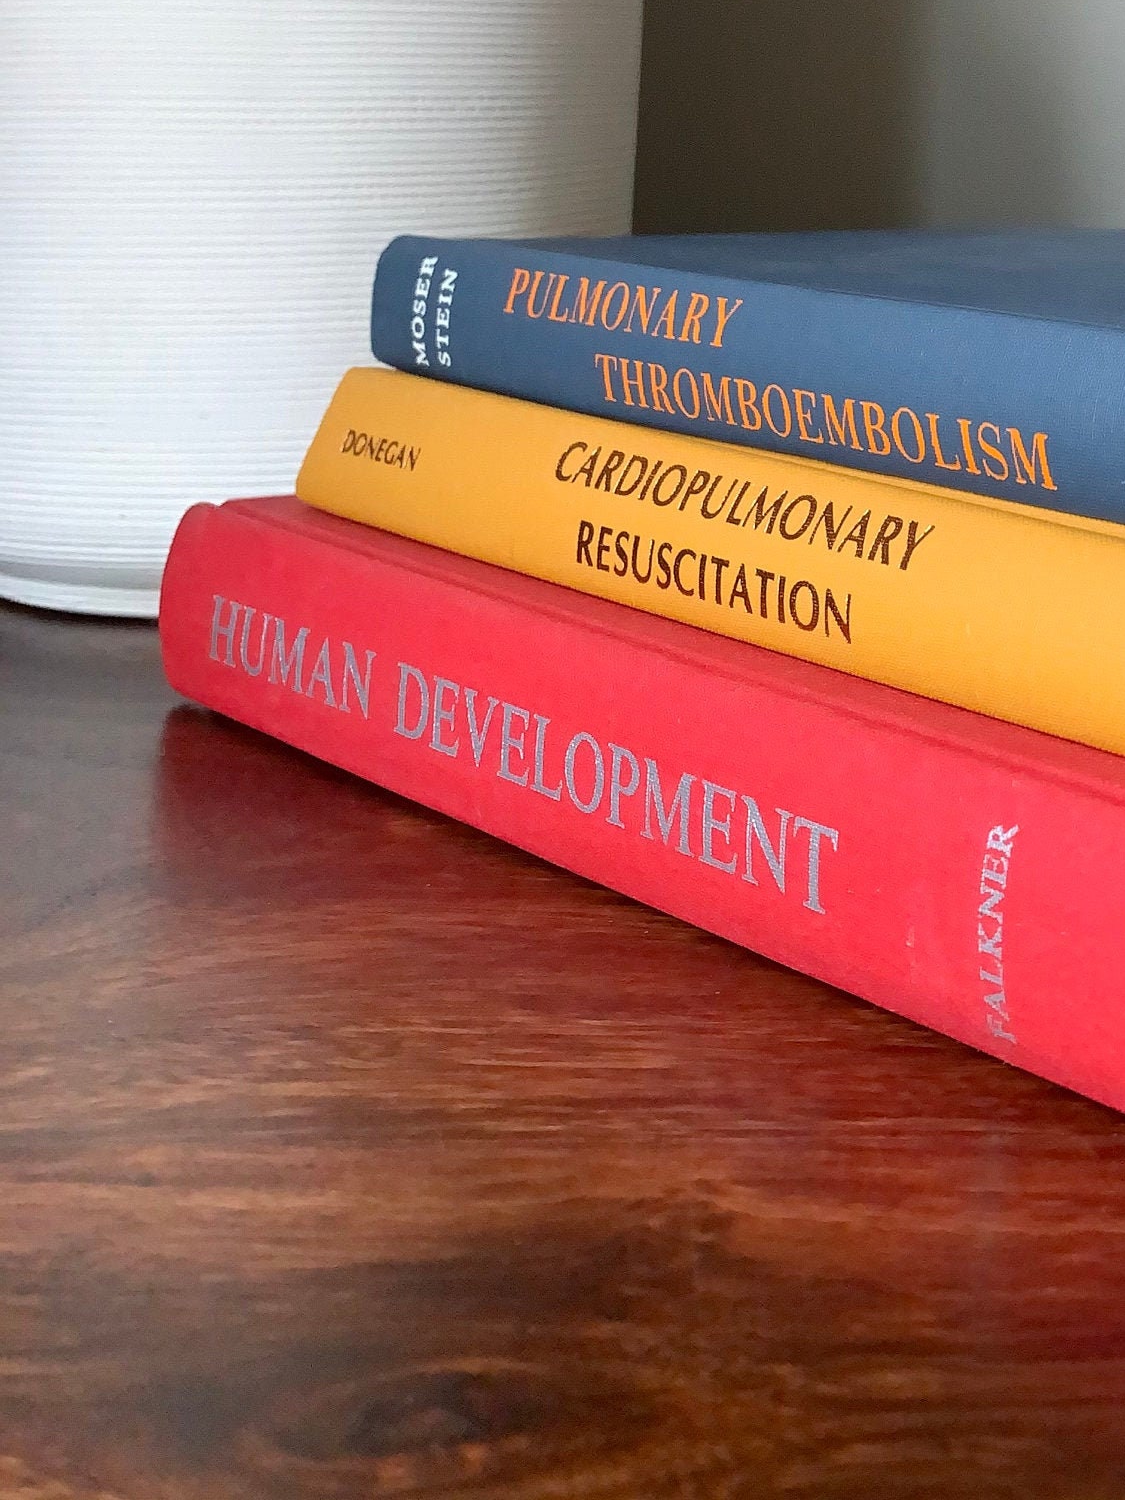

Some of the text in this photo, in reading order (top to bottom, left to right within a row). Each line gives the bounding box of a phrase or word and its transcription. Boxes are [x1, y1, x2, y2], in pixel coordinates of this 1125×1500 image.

[411, 256, 439, 367] MOSER
[435, 268, 459, 367] STEIN
[503, 268, 743, 348] PULMONARY
[341, 429, 421, 472] DONEGAN
[595, 353, 1057, 491] THROMBOEMBOLISM
[555, 441, 935, 572] CARDIOPULMONARY
[576, 519, 852, 644] RESUSCITATION
[209, 594, 840, 915] HUMAN DEVELOPMENT
[977, 823, 1020, 1045] FALKNER
